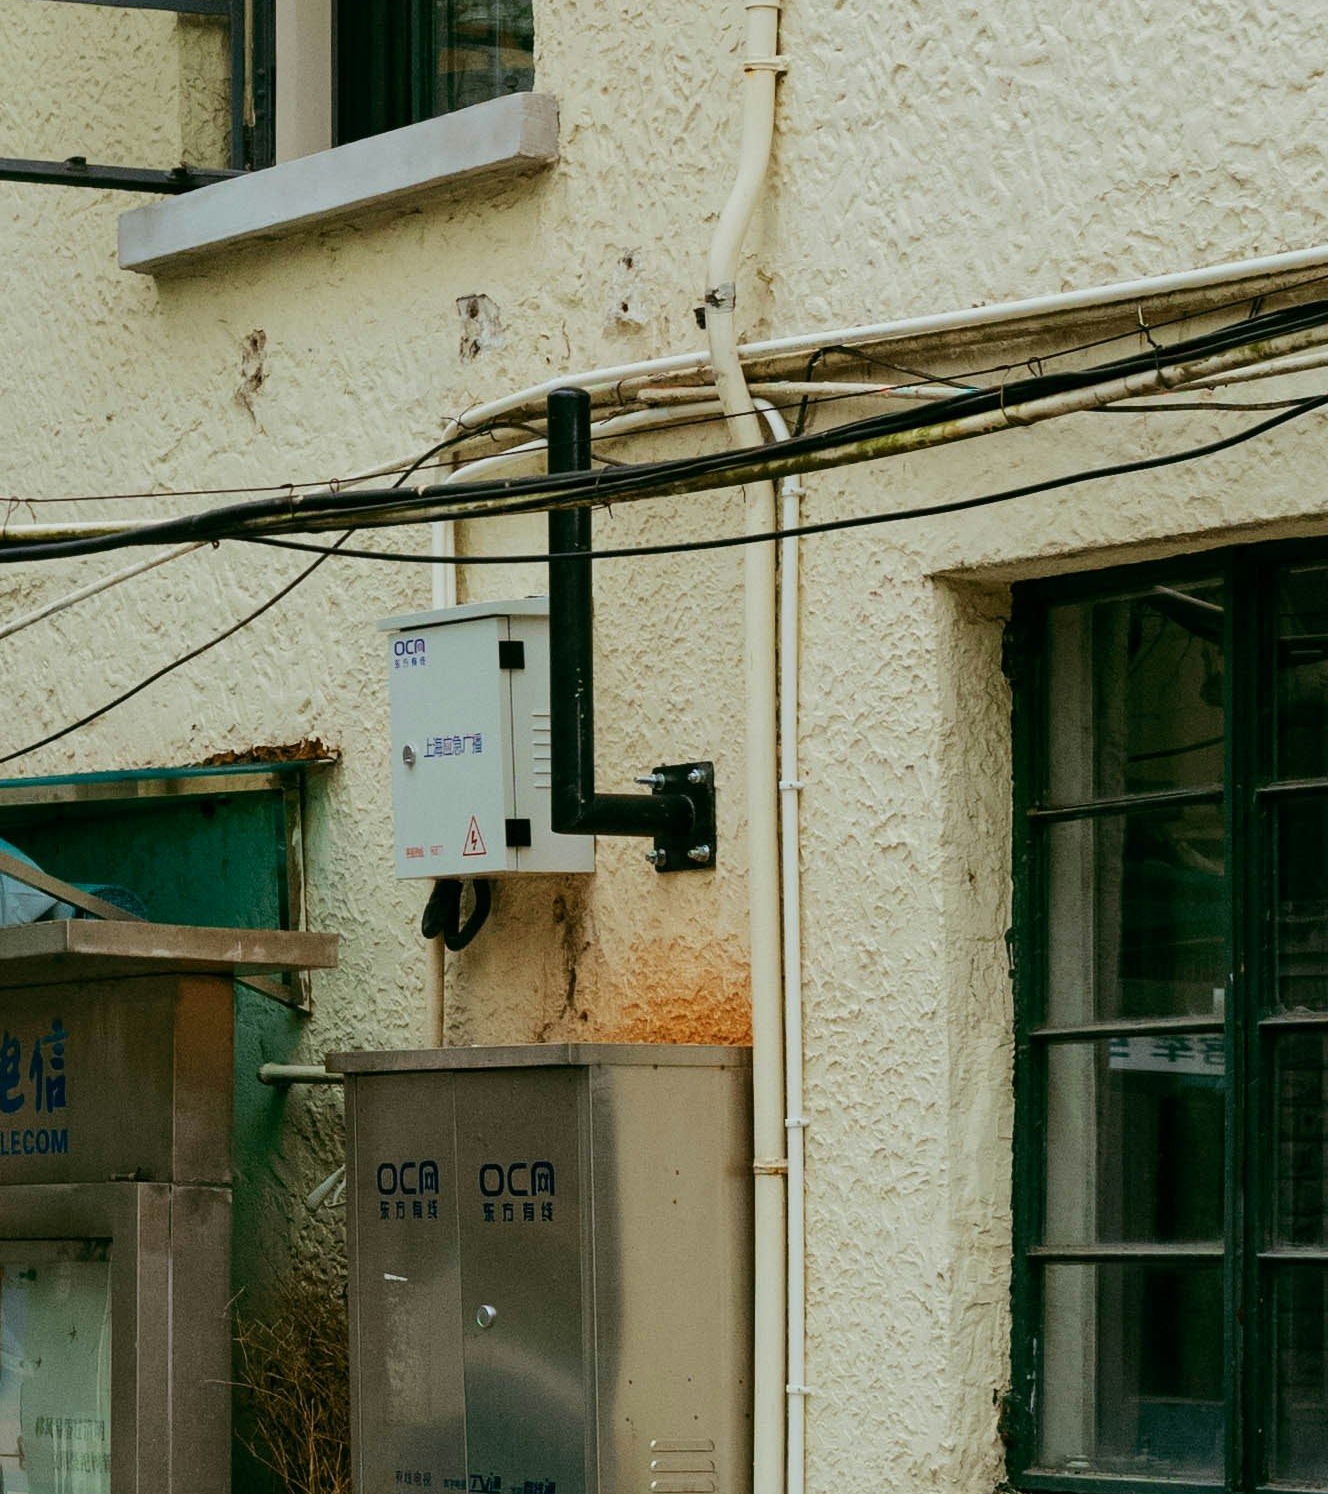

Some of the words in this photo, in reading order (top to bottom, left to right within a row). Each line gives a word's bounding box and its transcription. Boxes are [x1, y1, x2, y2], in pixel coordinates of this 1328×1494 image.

[380, 1200, 438, 1221] 东方有线
[483, 1202, 554, 1222] 东方有线
